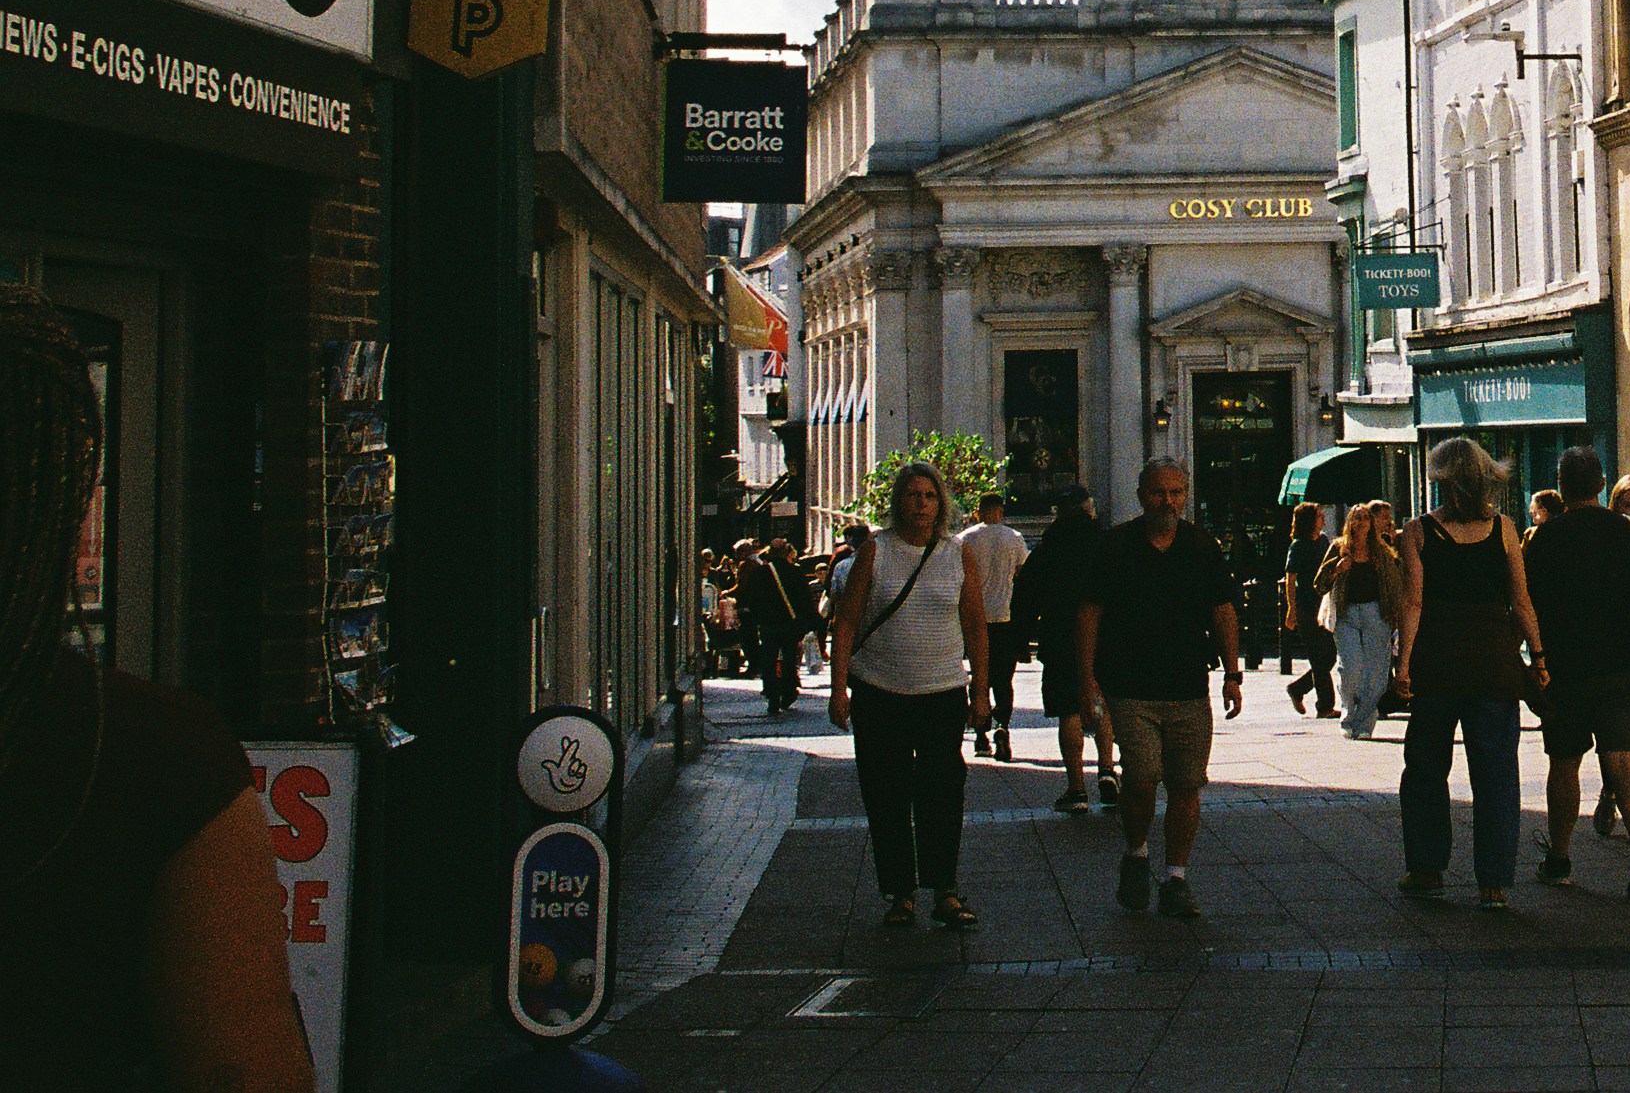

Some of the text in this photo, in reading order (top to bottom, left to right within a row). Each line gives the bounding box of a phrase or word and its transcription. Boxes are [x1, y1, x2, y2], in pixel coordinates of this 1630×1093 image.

[71, 30, 146, 85] E-CIGS
[156, 52, 221, 104] VAPES
[229, 72, 351, 135] CONVENIENCE
[685, 102, 785, 130] Barratt
[1169, 198, 1314, 219] COSY CLUB
[1365, 268, 1431, 280] TICKETY-BOO!
[1378, 284, 1420, 298] TOYS
[1463, 376, 1531, 403] TICKETY-BOO!
[531, 870, 590, 898] Play
[530, 897, 590, 919] here
